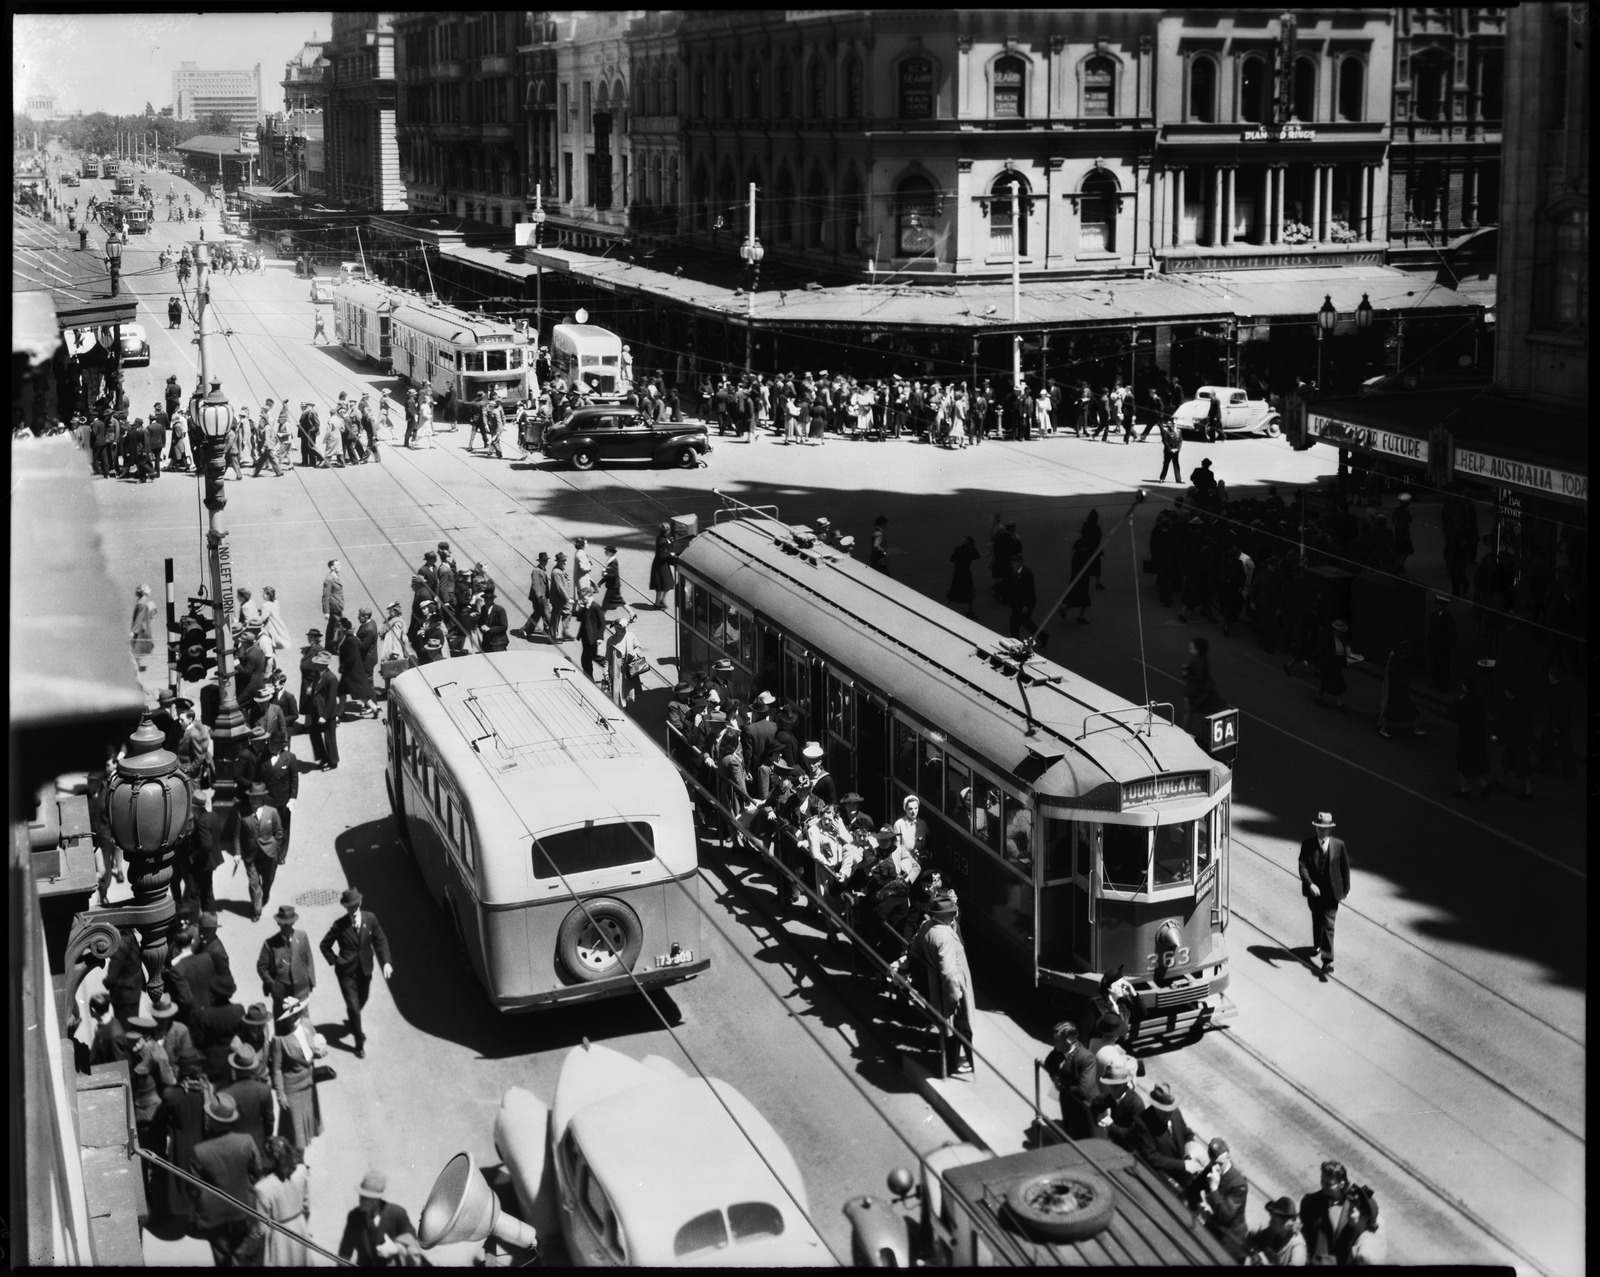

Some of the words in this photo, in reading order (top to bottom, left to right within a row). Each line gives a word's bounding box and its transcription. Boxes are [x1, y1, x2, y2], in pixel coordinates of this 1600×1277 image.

[1244, 131, 1287, 140] DIAMOND
[1288, 130, 1316, 139] RINGS
[522, 321, 529, 330] 7
[792, 322, 889, 332] DAMMAN
[1382, 433, 1421, 459] FUTURE
[1461, 451, 1485, 473] HELP
[1490, 458, 1553, 490] AUSTRALIA
[1499, 505, 1521, 519] STORE
[218, 546, 230, 561] NO
[220, 562, 232, 584] LEFT
[222, 586, 235, 614] TURN
[1214, 720, 1234, 743] 6A
[1146, 946, 1191, 971] 363
